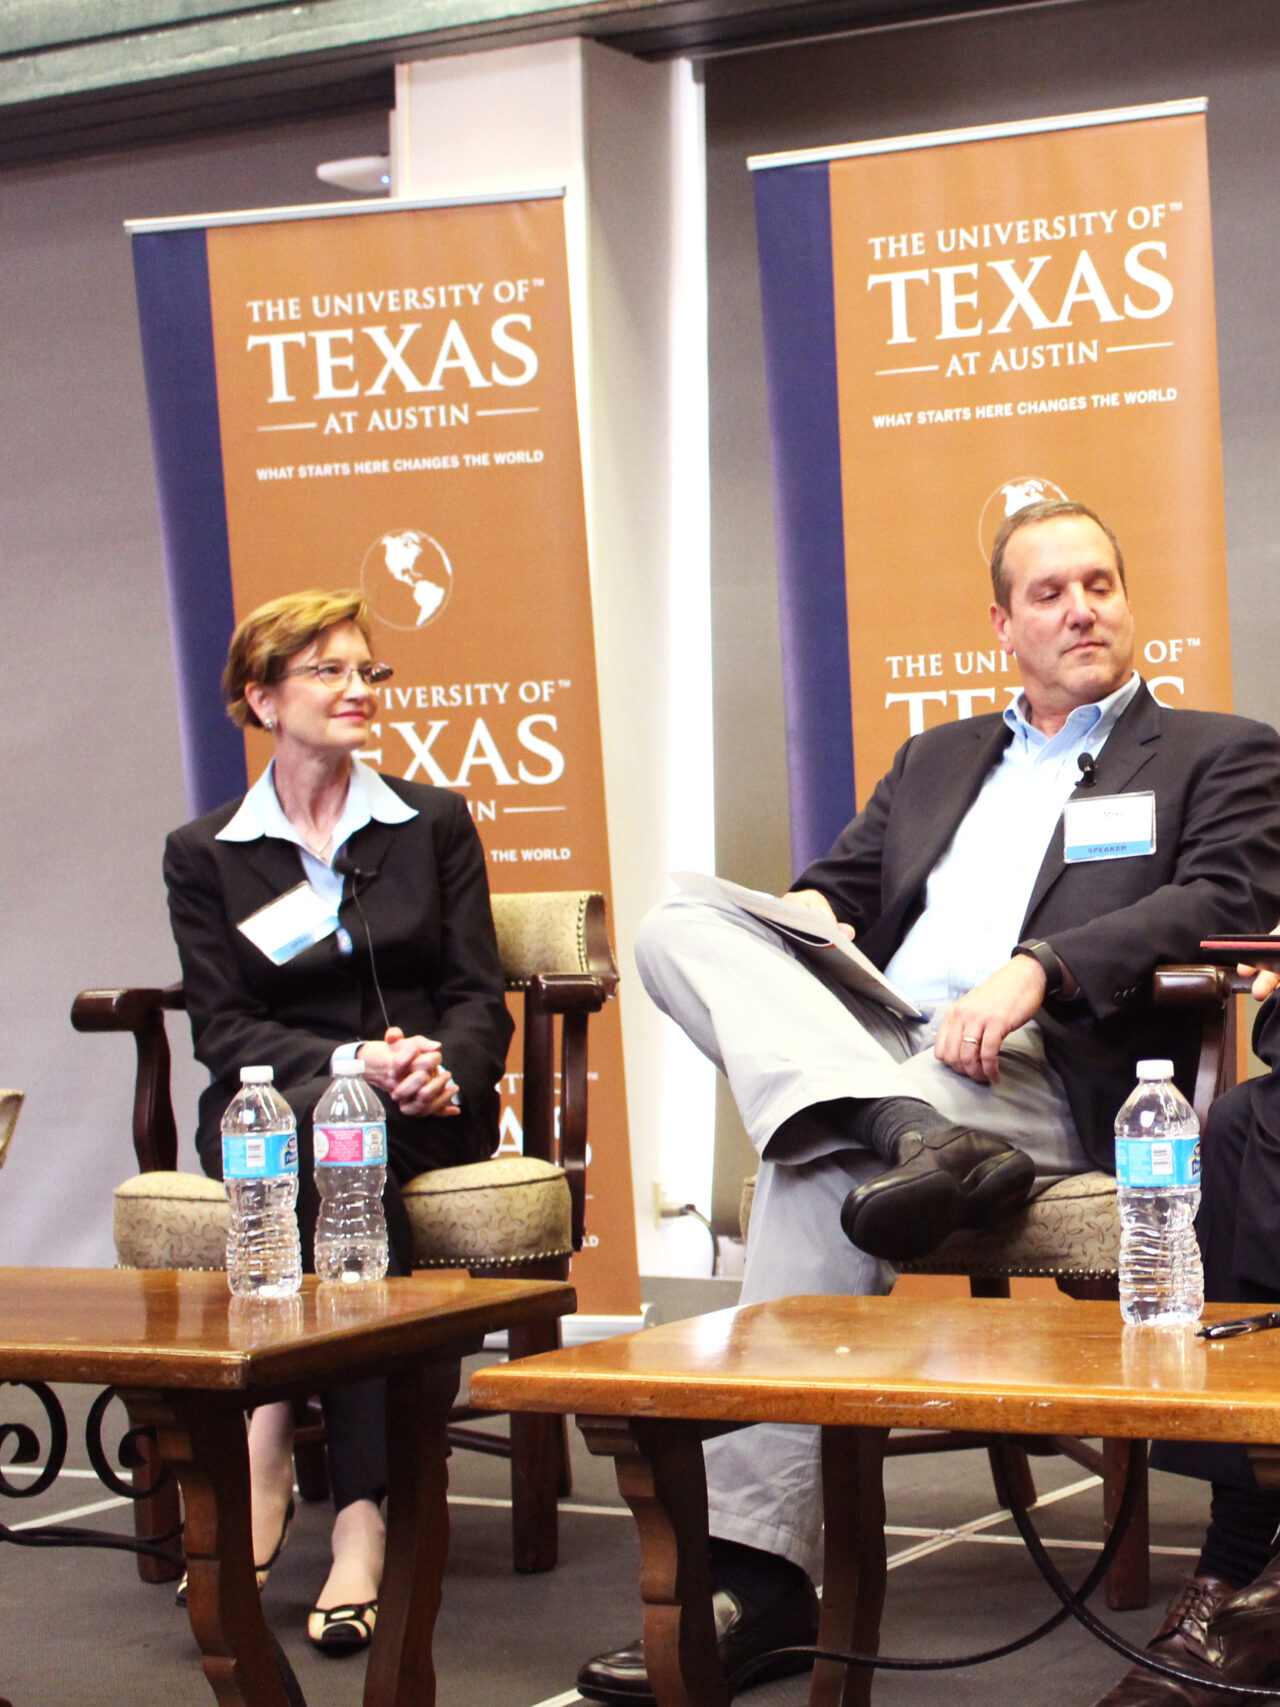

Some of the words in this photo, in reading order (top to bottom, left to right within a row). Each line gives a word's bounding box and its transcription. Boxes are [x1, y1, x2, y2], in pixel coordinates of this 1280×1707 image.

[868, 233, 925, 260] THE
[937, 210, 1117, 252] UNIVERSITY
[247, 298, 301, 322] THE
[312, 283, 483, 317] UNIVERSITY
[867, 241, 1174, 344] TEXAS
[247, 314, 538, 403] TEXAS
[946, 352, 981, 377] AT
[989, 340, 1098, 372] AUSTIN
[324, 412, 358, 434] AT
[368, 404, 469, 432] AUSTIN
[873, 413, 913, 428] WHAT
[917, 408, 971, 424] STARTS
[976, 403, 1013, 418] HERE
[1017, 397, 1087, 415] CHANGES
[1091, 393, 1120, 408] THE
[1124, 388, 1178, 404] WORLD
[256, 467, 294, 480] WHAT
[298, 463, 351, 478] STARTS
[354, 460, 390, 474] HERE
[393, 456, 460, 472] CHANGES
[463, 453, 490, 466] THE
[494, 450, 544, 464] WORLD
[886, 654, 943, 678] THE
[375, 682, 510, 710] IVERSITY
[353, 714, 566, 787] XAS
[491, 850, 517, 861] THE
[521, 848, 571, 861] WORLD
[1088, 845, 1126, 854] SPEAKER
